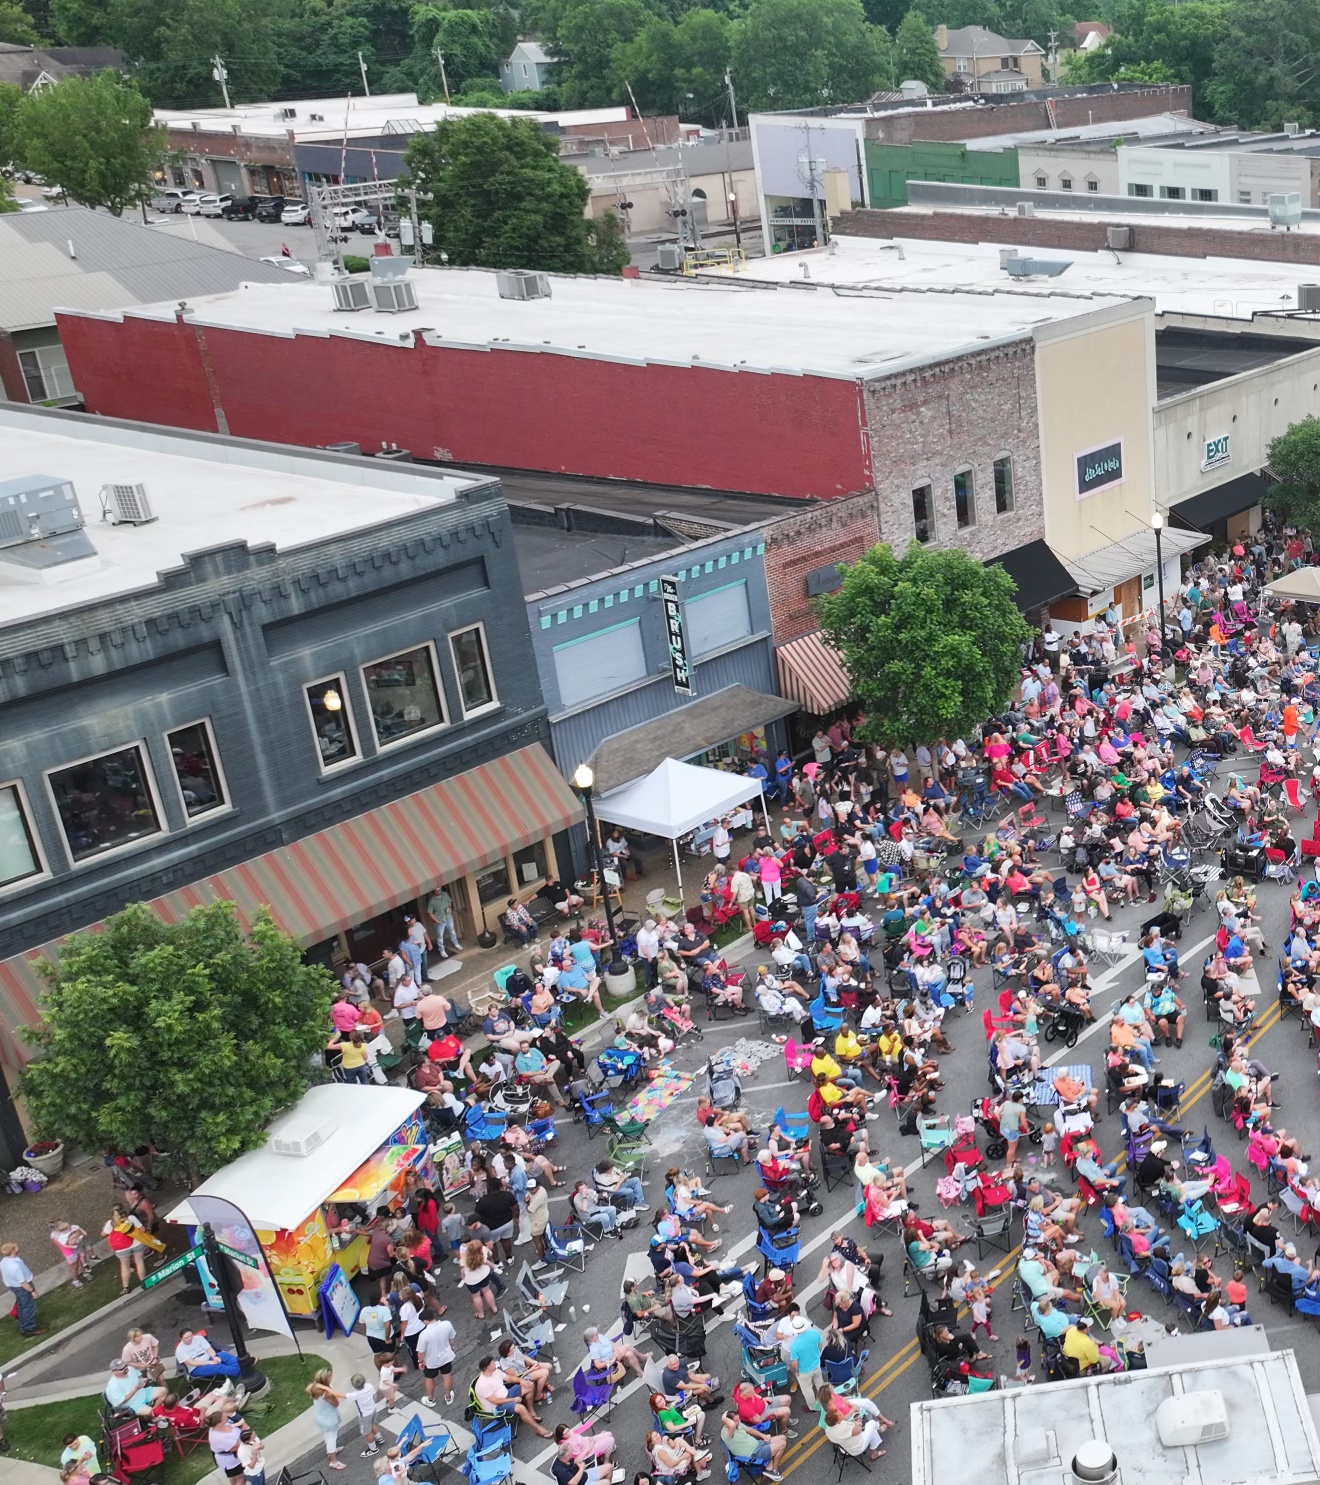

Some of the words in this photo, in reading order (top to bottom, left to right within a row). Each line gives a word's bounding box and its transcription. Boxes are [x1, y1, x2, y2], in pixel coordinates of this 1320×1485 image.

[1206, 435, 1230, 460] EXIT
[667, 602, 687, 683] BRUSH
[158, 1259, 185, 1280] Marion
[186, 1250, 196, 1262] St
[224, 1246, 246, 1263] Market
[246, 1256, 254, 1267] St
